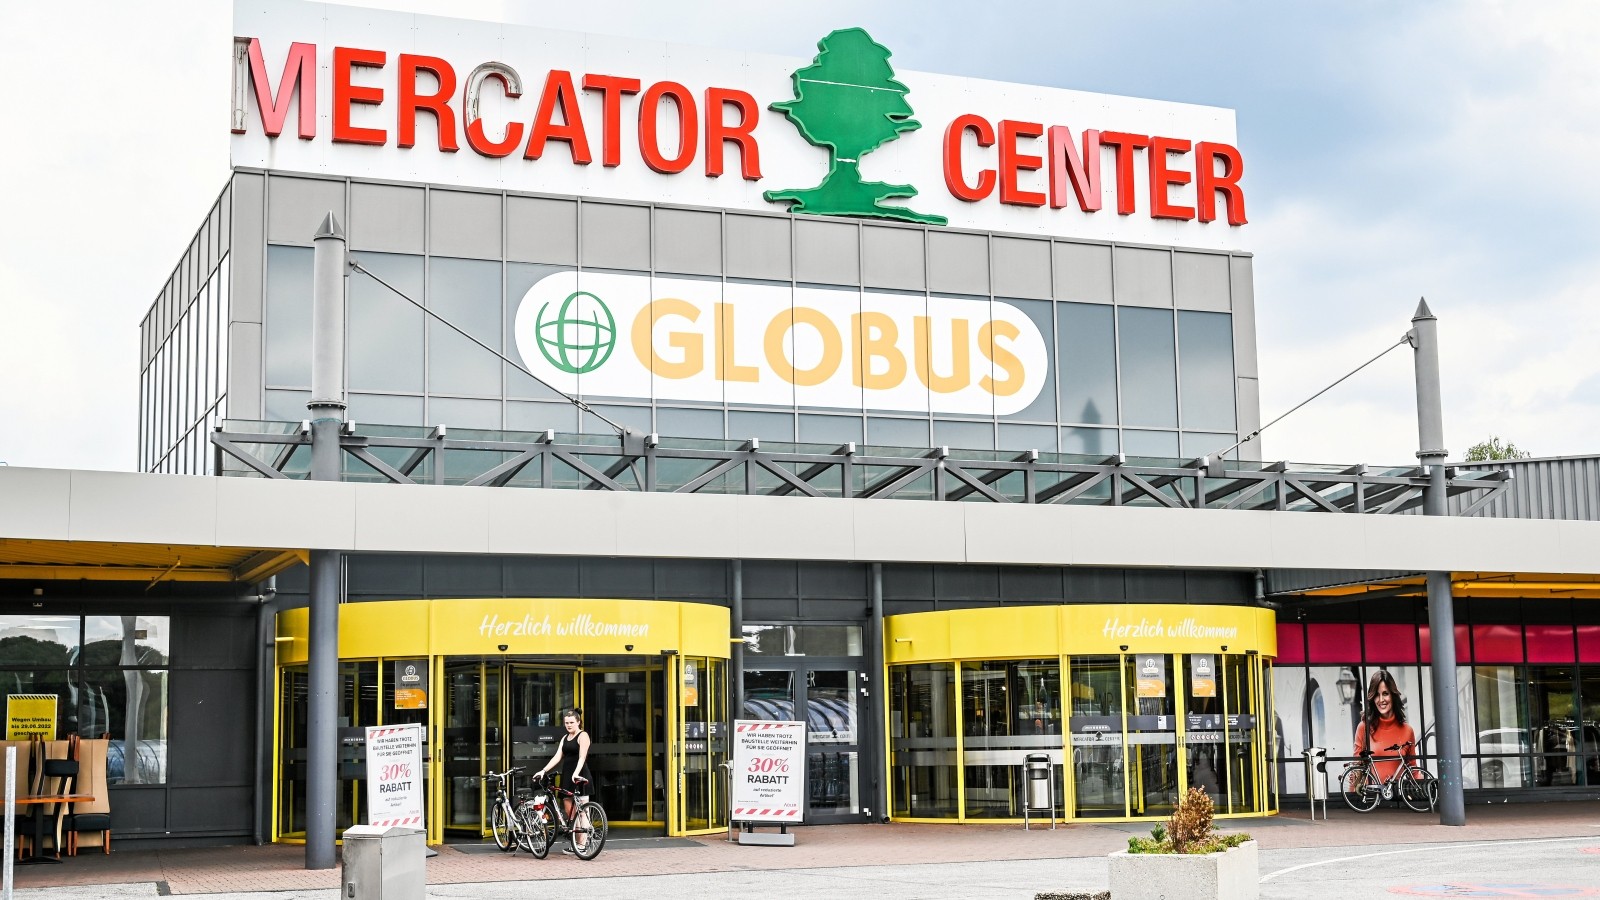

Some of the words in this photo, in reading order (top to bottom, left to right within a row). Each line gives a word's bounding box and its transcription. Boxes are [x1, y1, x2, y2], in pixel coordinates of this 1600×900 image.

[231, 36, 763, 181] MERCATOR
[943, 114, 1248, 226] CENTER
[631, 297, 1025, 397] GLOBUS
[479, 614, 551, 638] Herzlich
[556, 614, 649, 637] willkommen
[1103, 617, 1163, 640] Herzlich
[1167, 618, 1237, 638] willkommen
[380, 762, 411, 781] 30%
[748, 757, 789, 773] 30%
[380, 781, 411, 793] RABATT
[747, 774, 789, 784] RABATT
